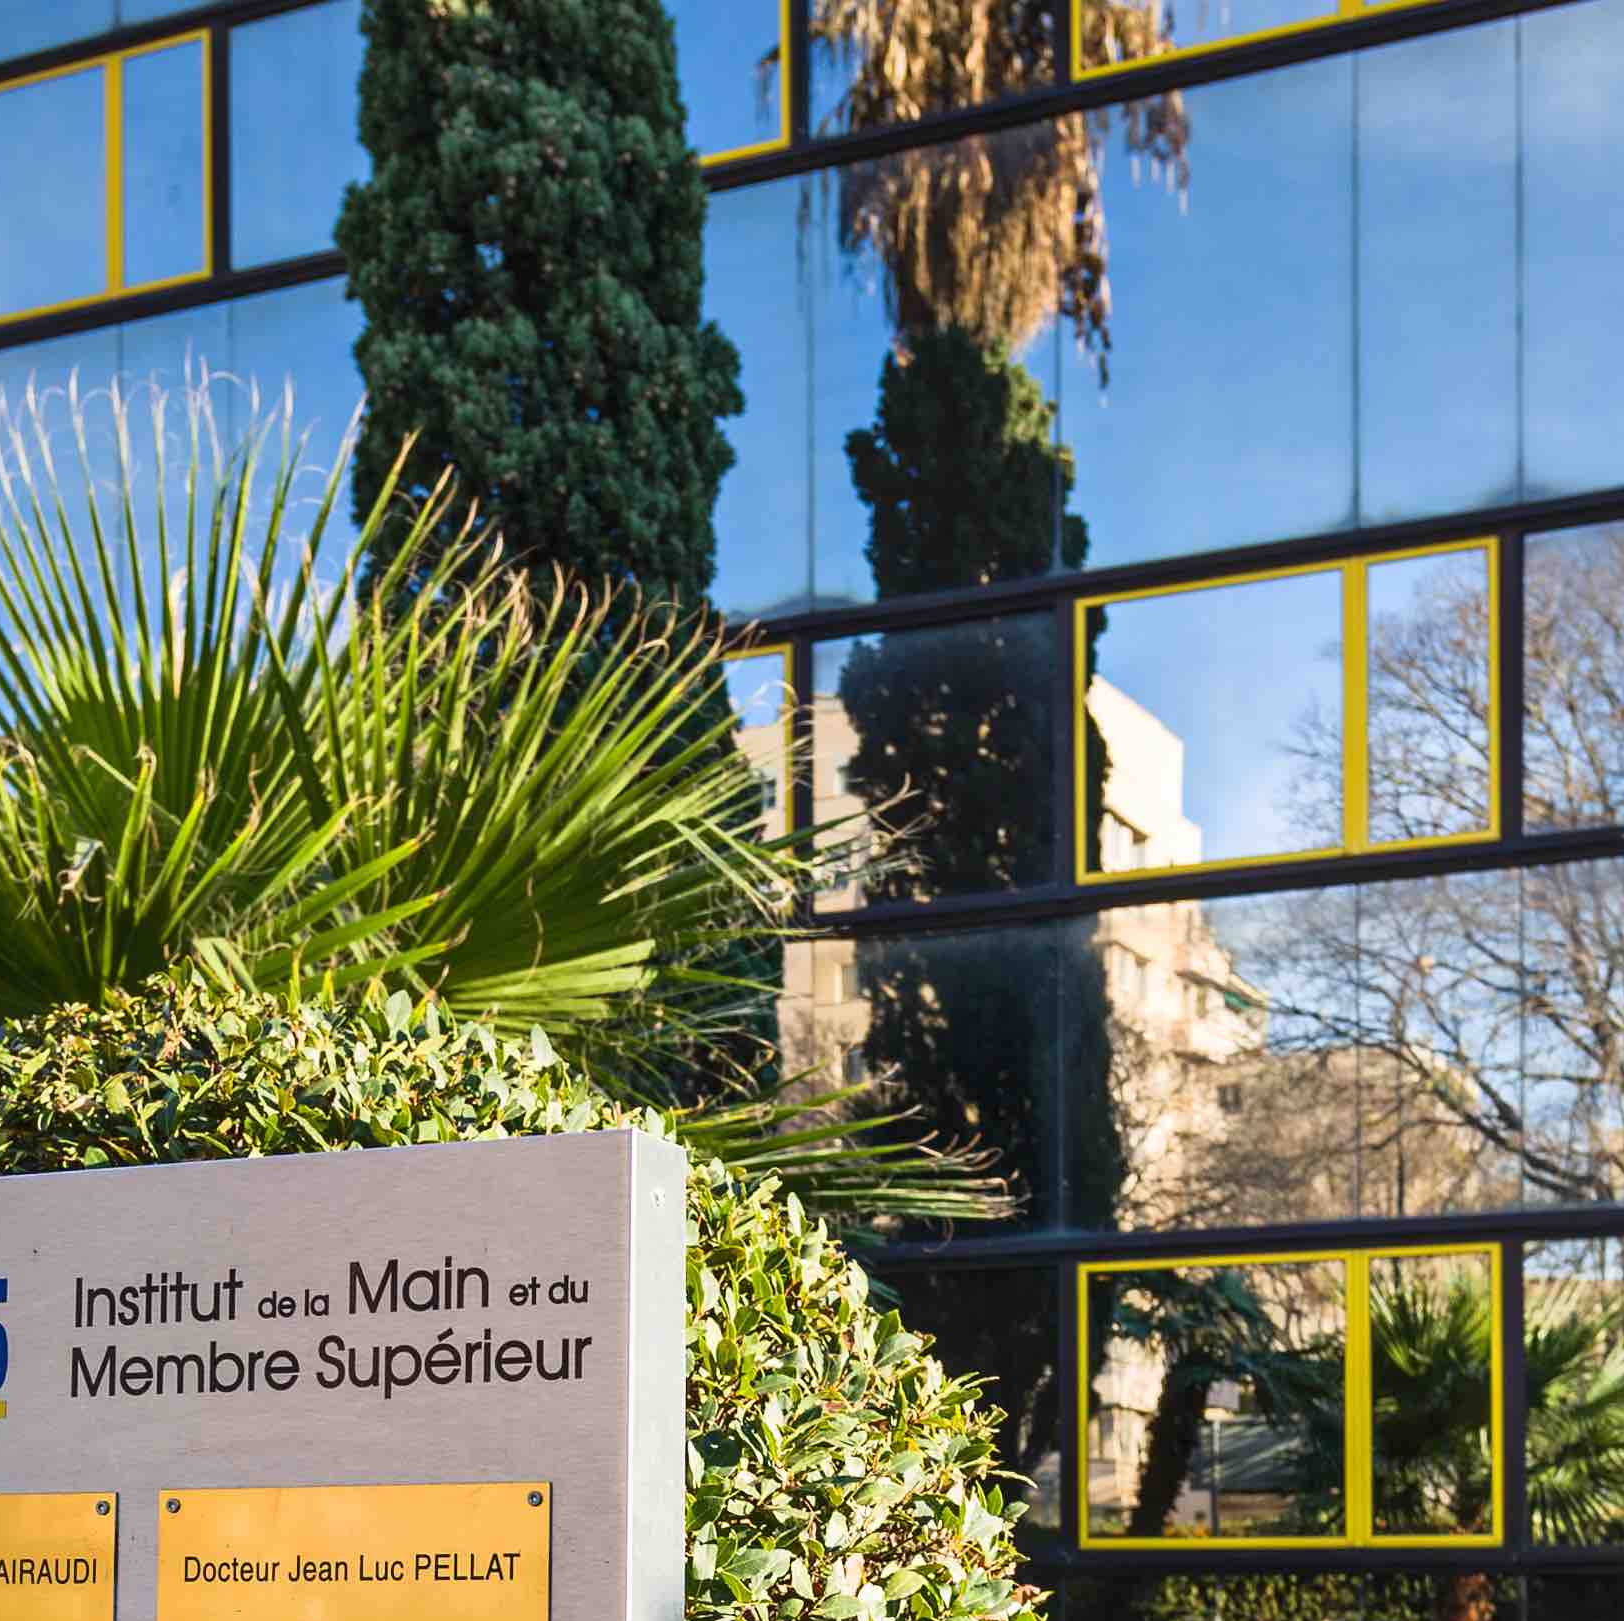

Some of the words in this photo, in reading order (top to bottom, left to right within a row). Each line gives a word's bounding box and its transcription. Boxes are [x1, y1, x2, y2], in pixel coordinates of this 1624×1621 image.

[74, 1268, 244, 1329] Institut
[258, 1291, 299, 1318] de
[303, 1289, 330, 1316] la
[348, 1255, 489, 1316] Main
[508, 1280, 541, 1307] et
[547, 1273, 589, 1304] du
[71, 1340, 299, 1399] Membre
[317, 1328, 592, 1399] Supérieur
[184, 1556, 279, 1582] Docteur
[288, 1554, 348, 1582] Jean
[359, 1554, 404, 1581] Luc
[414, 1552, 521, 1581] PELLAT
